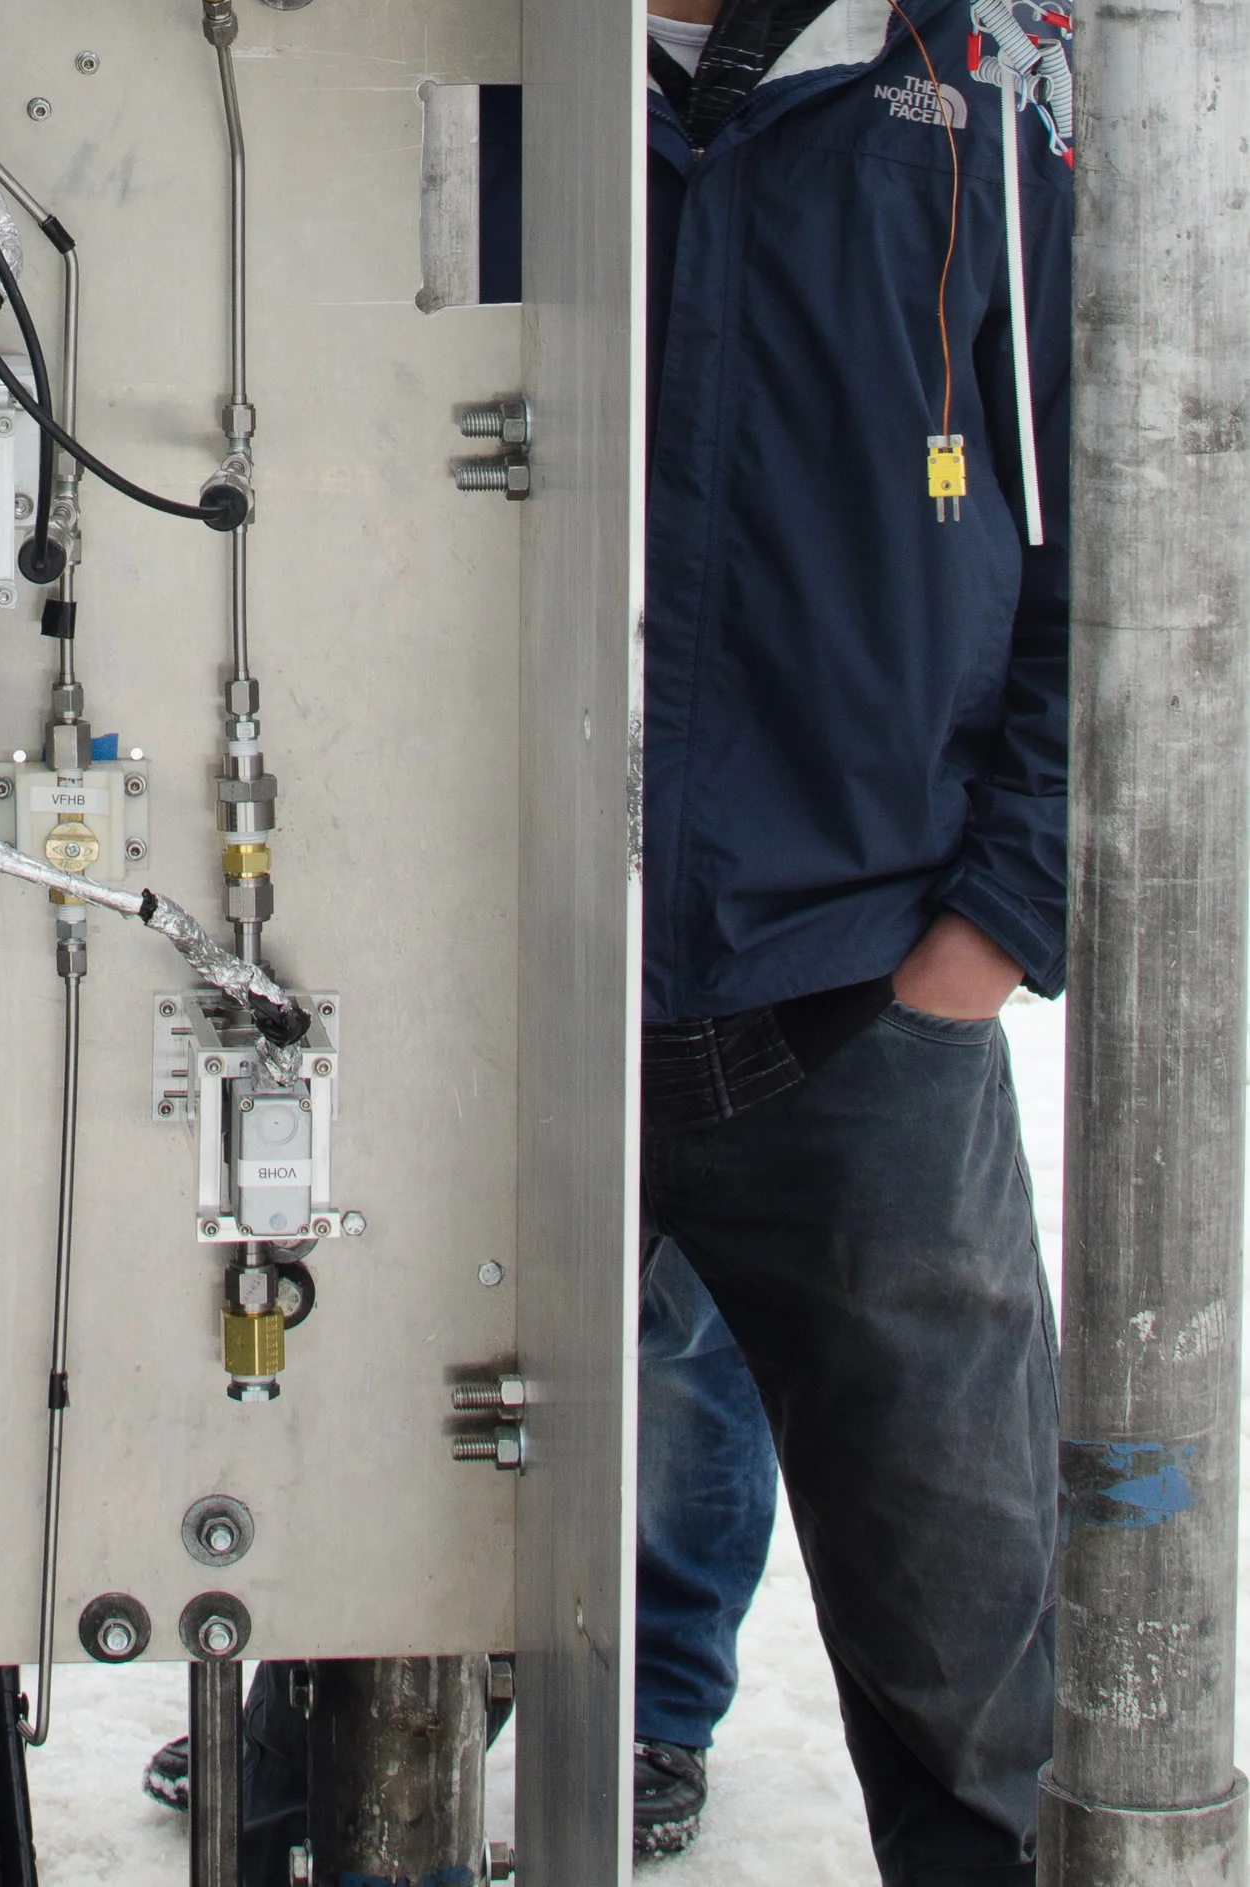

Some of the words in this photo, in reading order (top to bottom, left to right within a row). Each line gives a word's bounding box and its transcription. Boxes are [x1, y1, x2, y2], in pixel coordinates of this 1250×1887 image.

[903, 75, 938, 96] THE
[873, 84, 938, 111] NORTH
[889, 101, 934, 124] FACE
[51, 793, 86, 806] VFHB
[258, 1167, 297, 1180] VOHB
